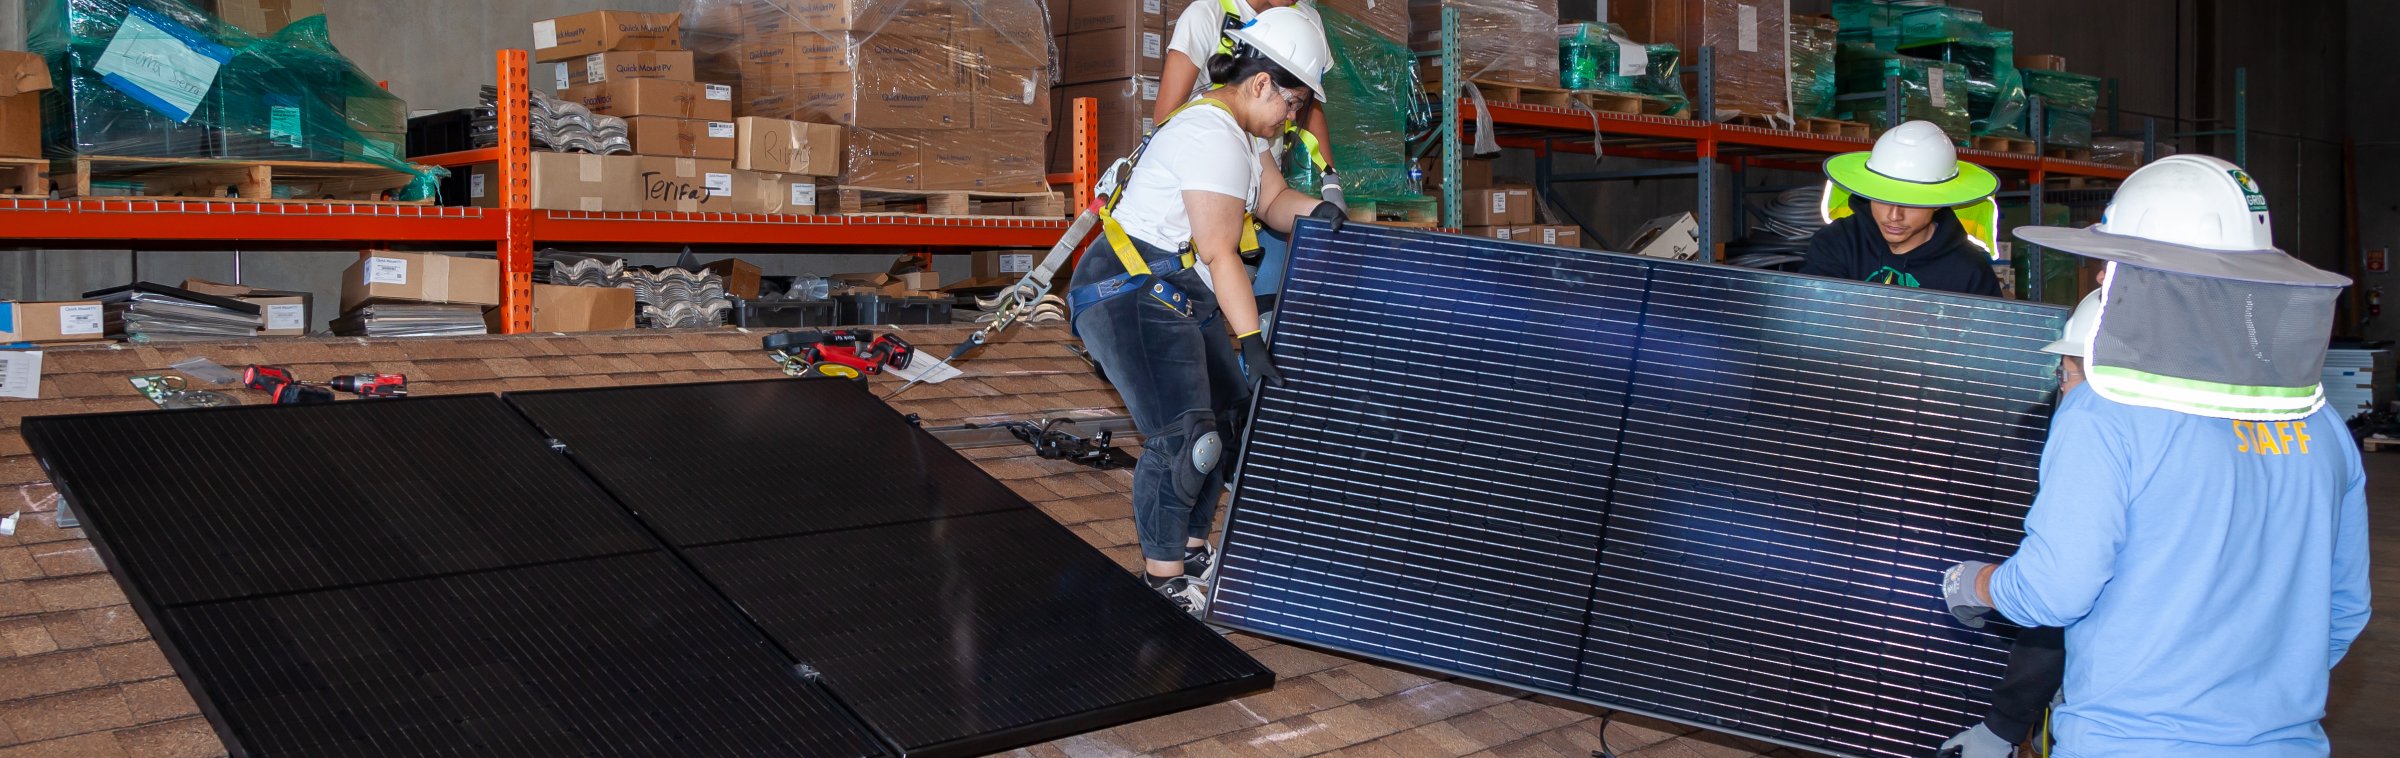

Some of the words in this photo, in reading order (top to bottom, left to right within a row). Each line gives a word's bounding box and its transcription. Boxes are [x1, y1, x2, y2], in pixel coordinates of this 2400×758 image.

[619, 24, 639, 33] Quick
[616, 64, 638, 73] Quick
[639, 64, 660, 72] Mount
[2246, 194, 2266, 206] GRID
[2232, 420, 2311, 455] STAFF
